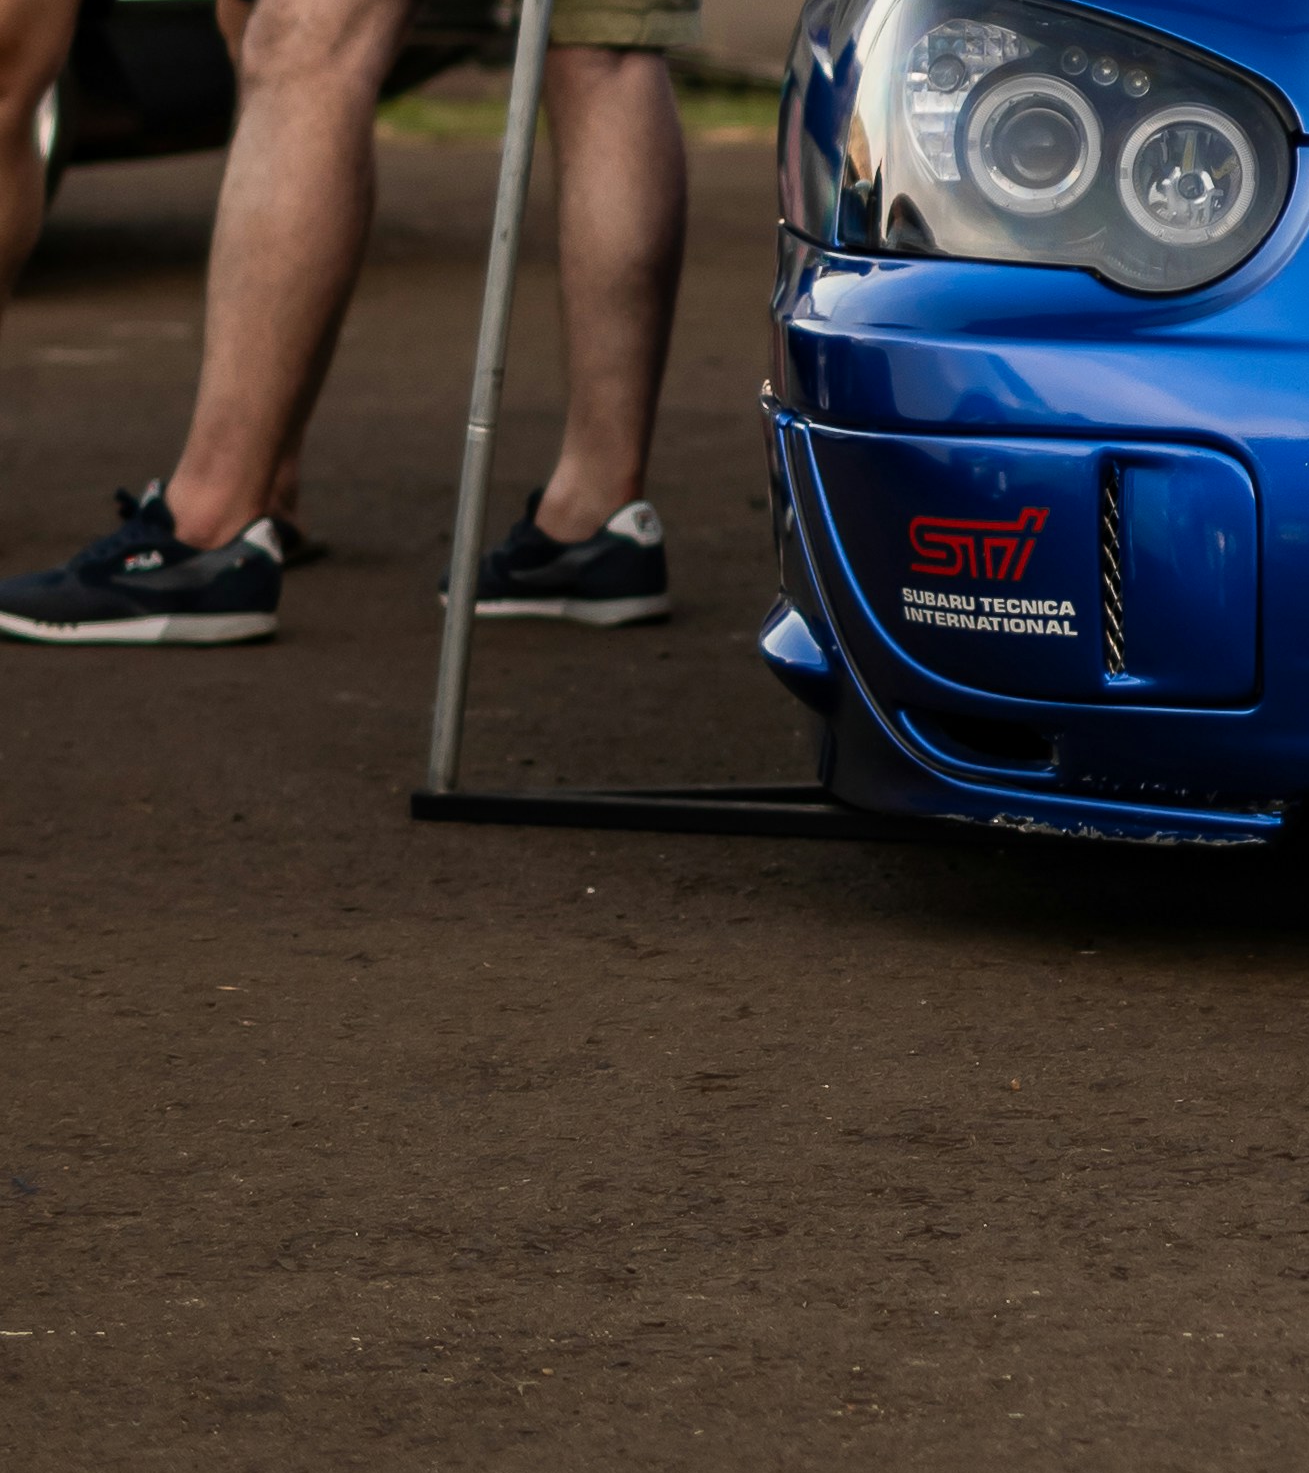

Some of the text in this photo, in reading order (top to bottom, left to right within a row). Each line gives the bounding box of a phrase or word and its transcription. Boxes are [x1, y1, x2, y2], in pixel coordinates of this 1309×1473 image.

[902, 587, 1077, 617] SUBARU TECNICA
[903, 606, 1079, 637] INTERNATIONAL
